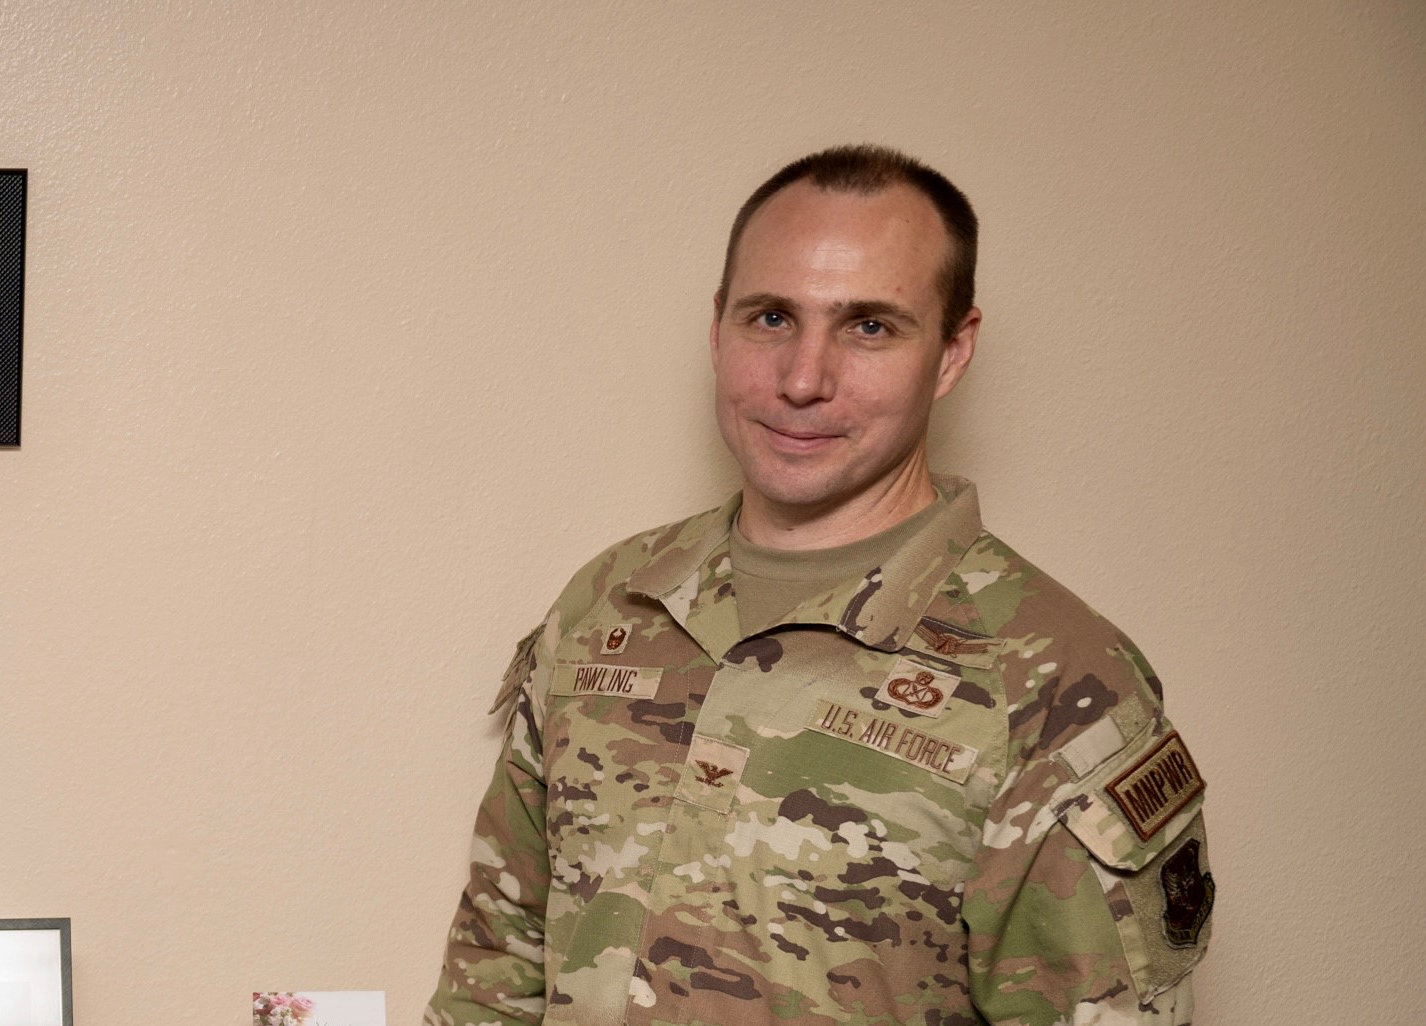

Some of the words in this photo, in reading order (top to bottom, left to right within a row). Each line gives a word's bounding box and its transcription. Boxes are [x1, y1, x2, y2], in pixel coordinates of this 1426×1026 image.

[573, 667, 637, 693] PAWLING
[820, 703, 857, 739] U.S.
[859, 718, 898, 750] AIR
[894, 727, 961, 774] FORCE
[1123, 748, 1193, 823] MNPWR
